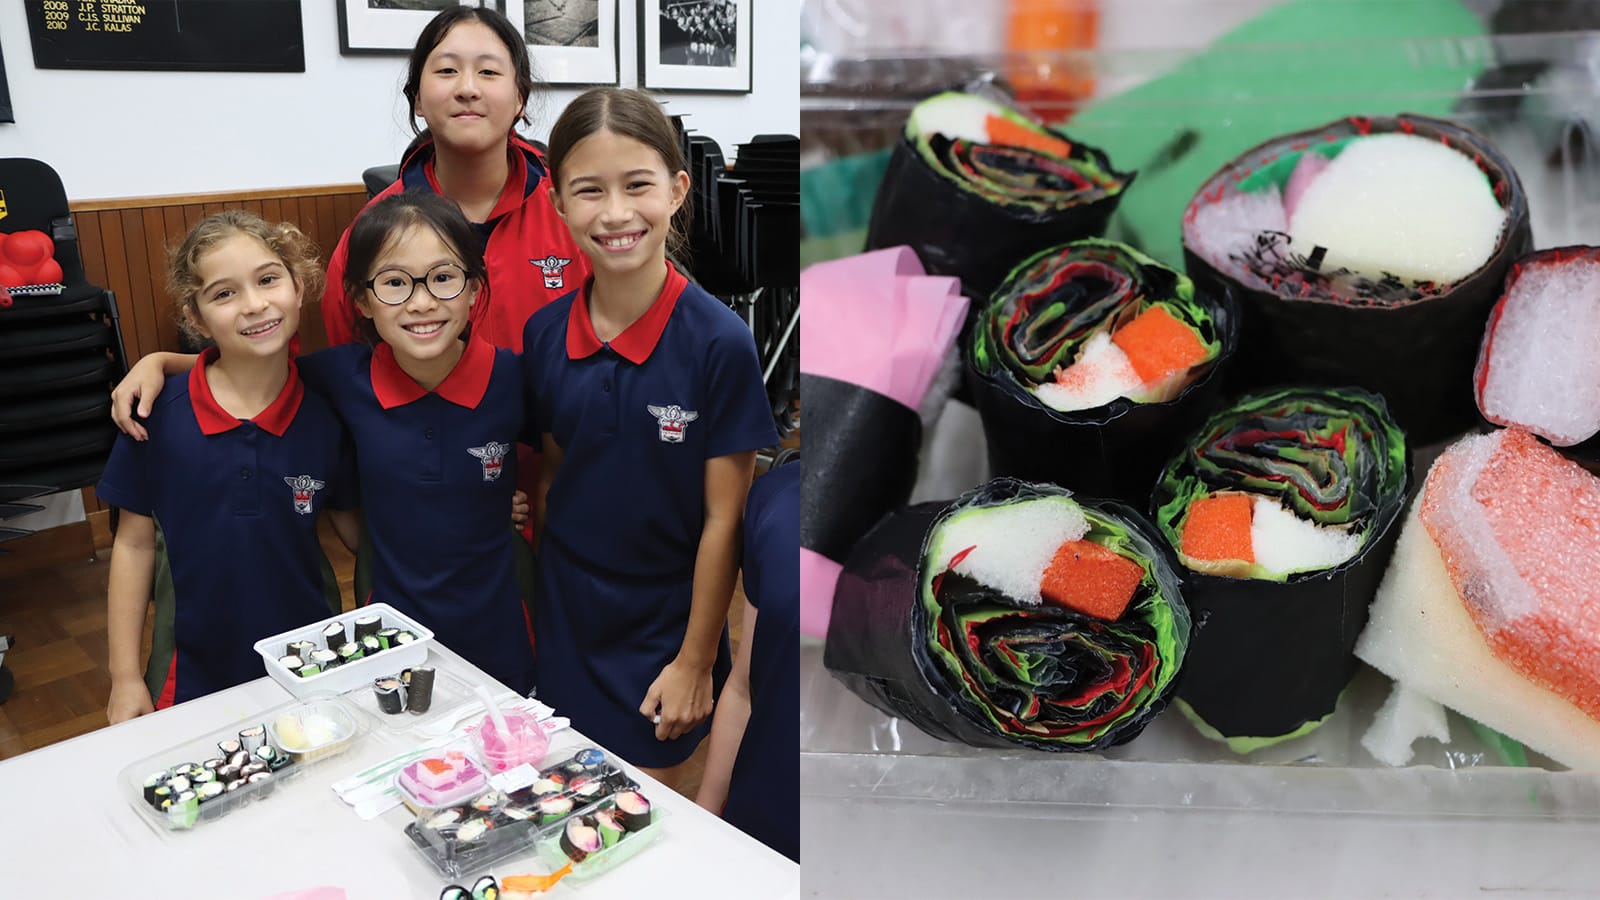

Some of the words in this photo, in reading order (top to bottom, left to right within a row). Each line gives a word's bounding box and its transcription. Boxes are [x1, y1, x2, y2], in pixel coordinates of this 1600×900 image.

[43, 1, 69, 11] 2008
[78, 2, 95, 12] J.P.
[101, 4, 146, 15] STRATTON
[45, 11, 69, 21] 2009
[102, 14, 141, 24] SULLIVAN
[46, 21, 67, 30] 2010
[104, 23, 132, 32] KALAS
